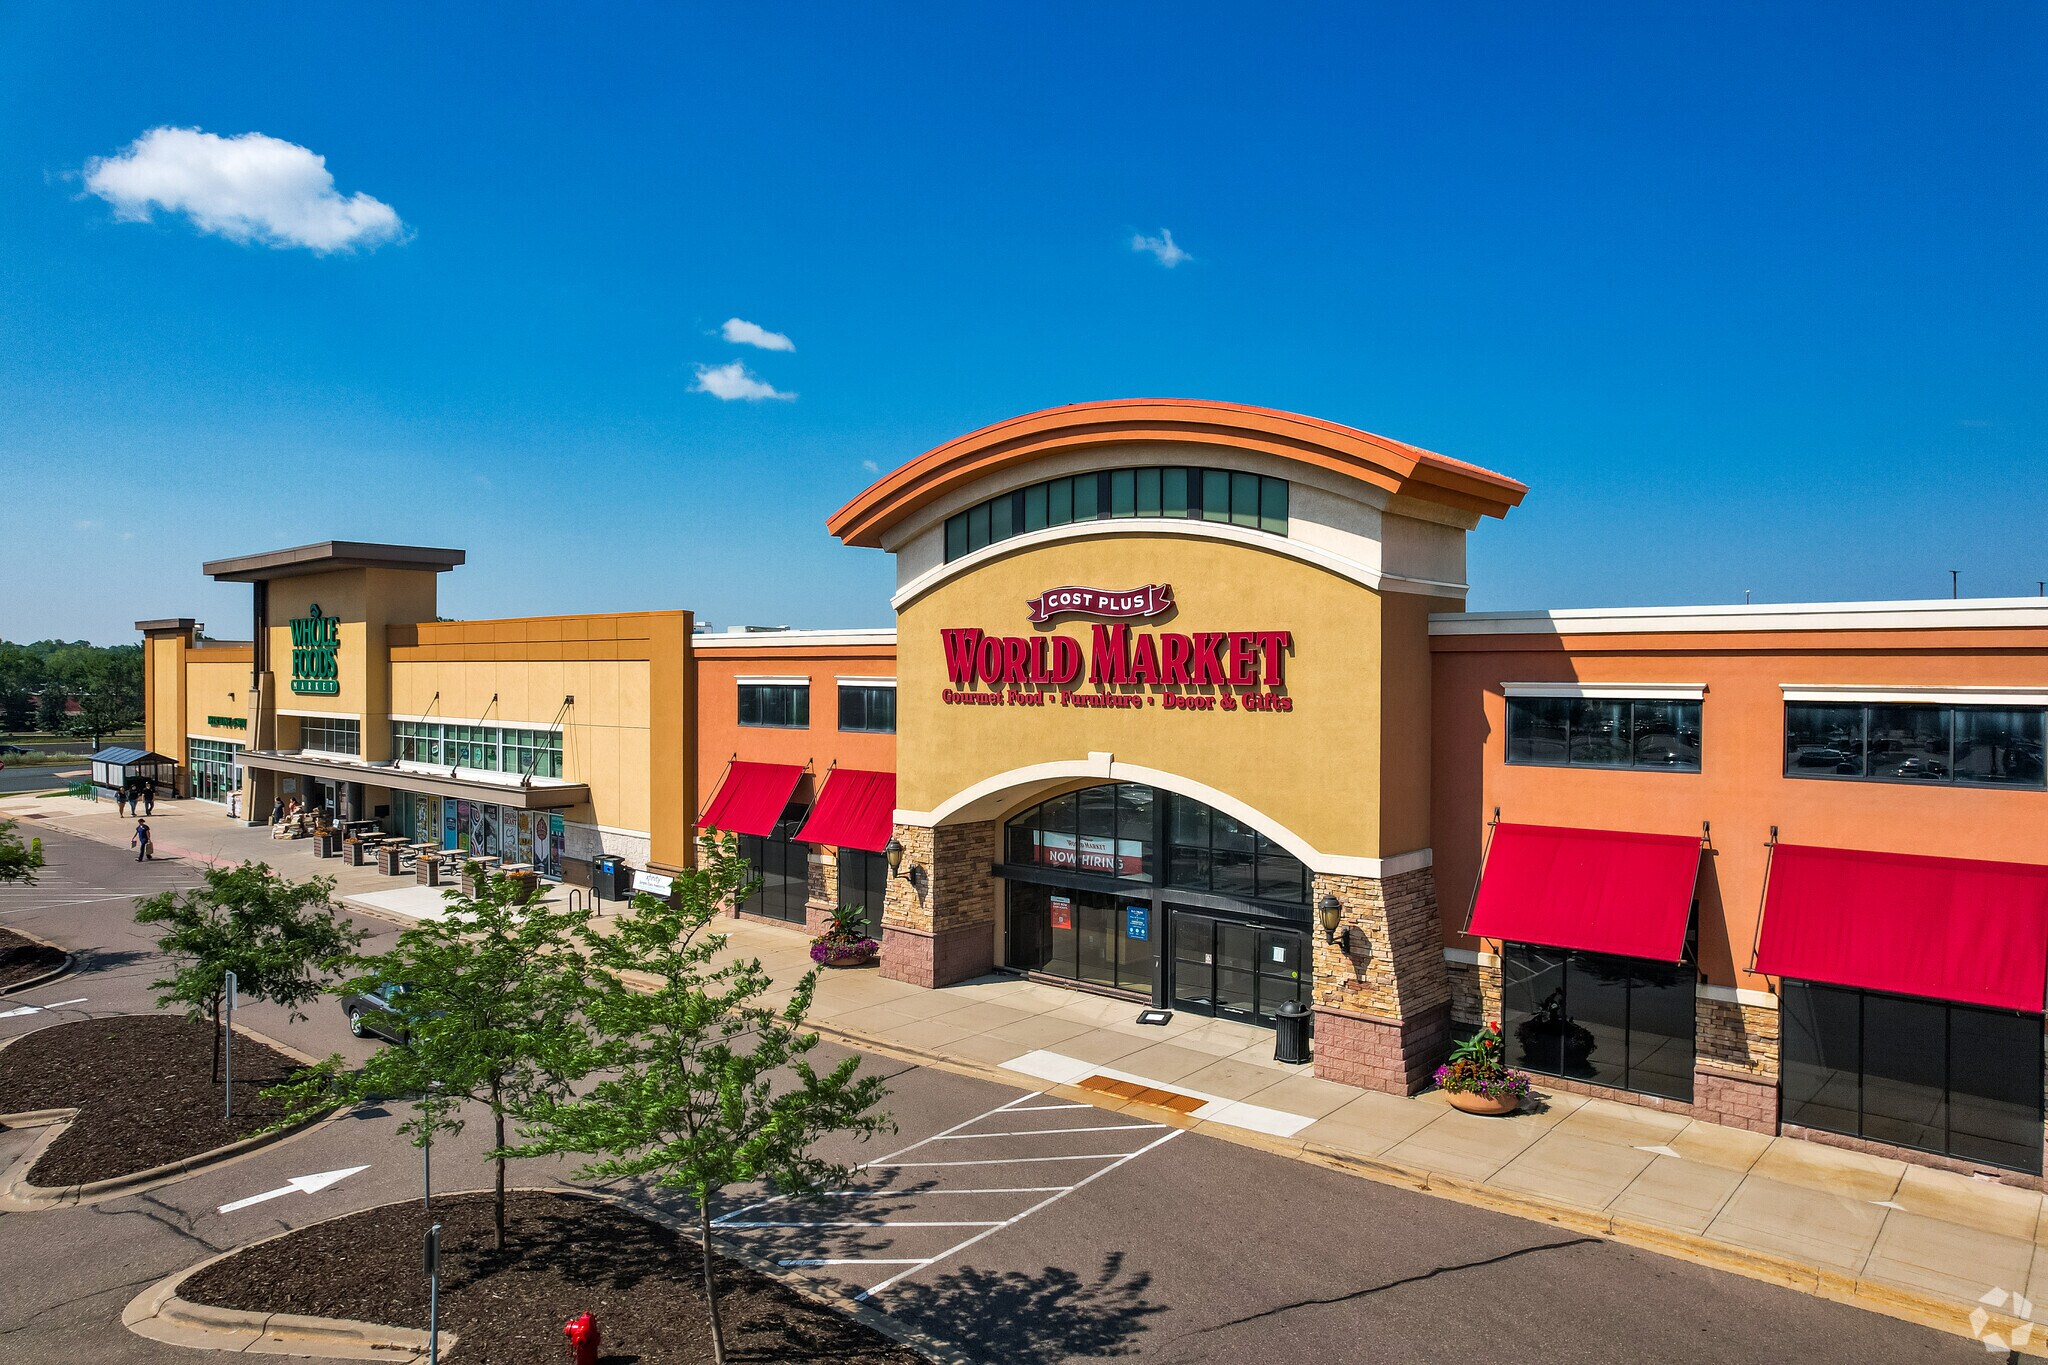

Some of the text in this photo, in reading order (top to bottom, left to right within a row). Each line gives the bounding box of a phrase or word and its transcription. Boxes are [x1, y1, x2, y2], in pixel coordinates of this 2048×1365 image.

[1048, 593, 1144, 610] COST PLUS
[289, 616, 340, 647] WHOLE
[292, 647, 338, 678] FOODS
[940, 623, 1292, 687] WORLD MARKET
[293, 681, 333, 691] MARKET
[942, 689, 1294, 712] Gourmet Food Furniture Decor & Gifts
[1084, 842, 1106, 850] MARKET
[1050, 851, 1124, 870] NOW HIRING
